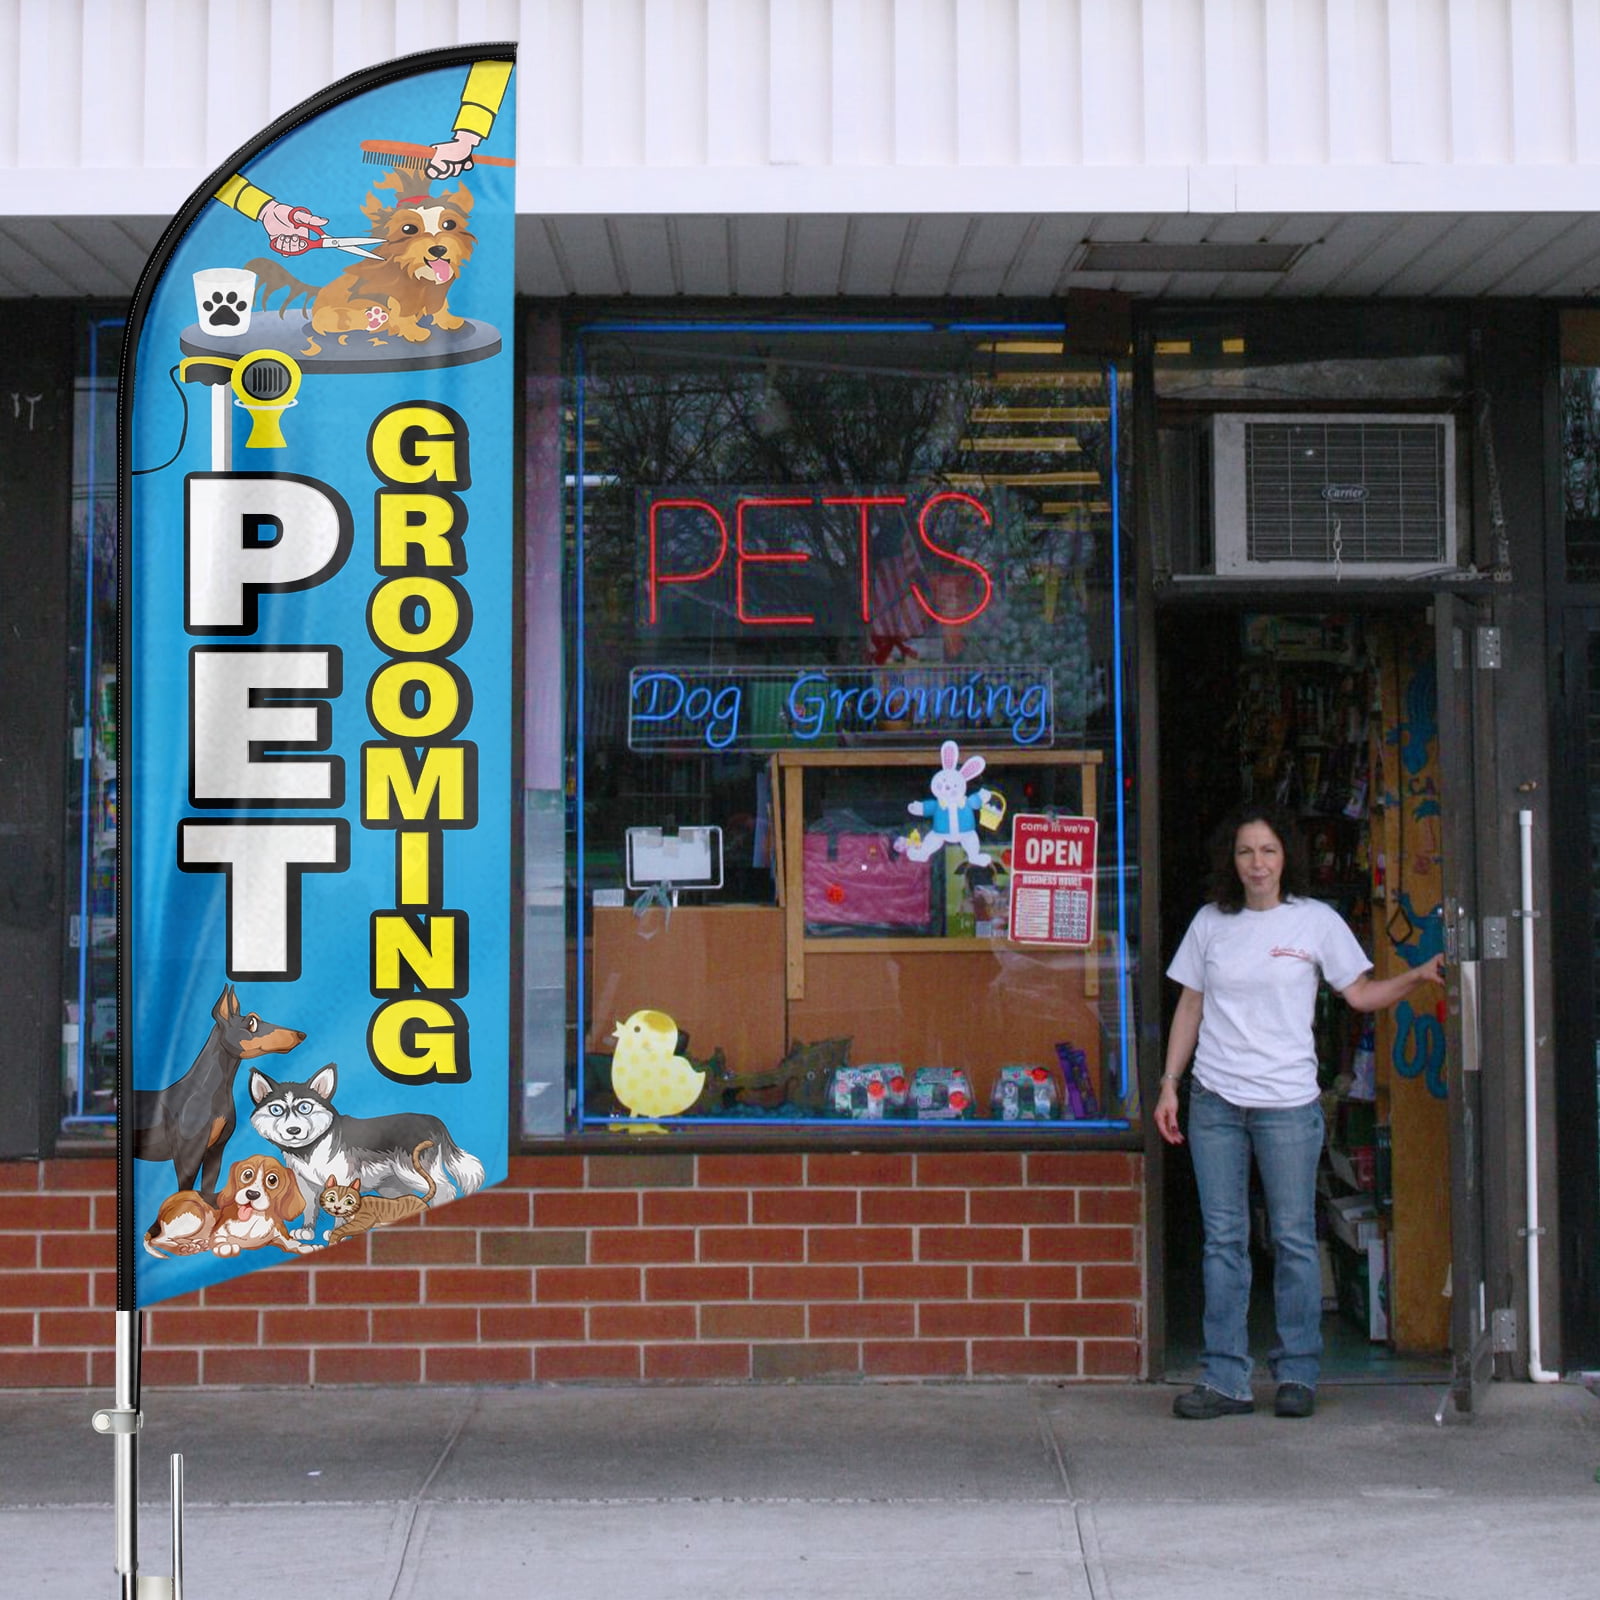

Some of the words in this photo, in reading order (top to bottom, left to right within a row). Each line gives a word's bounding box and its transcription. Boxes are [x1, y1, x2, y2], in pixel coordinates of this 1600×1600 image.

[1326, 486, 1364, 499] Carrier
[648, 492, 993, 626] PETS
[180, 473, 352, 980] PET
[362, 401, 476, 1083] GROOMING
[631, 671, 742, 749] Dog
[788, 670, 1050, 745] Grooming
[1020, 822, 1049, 832] come
[1063, 824, 1090, 834] we're
[1024, 837, 1083, 867] OPEN
